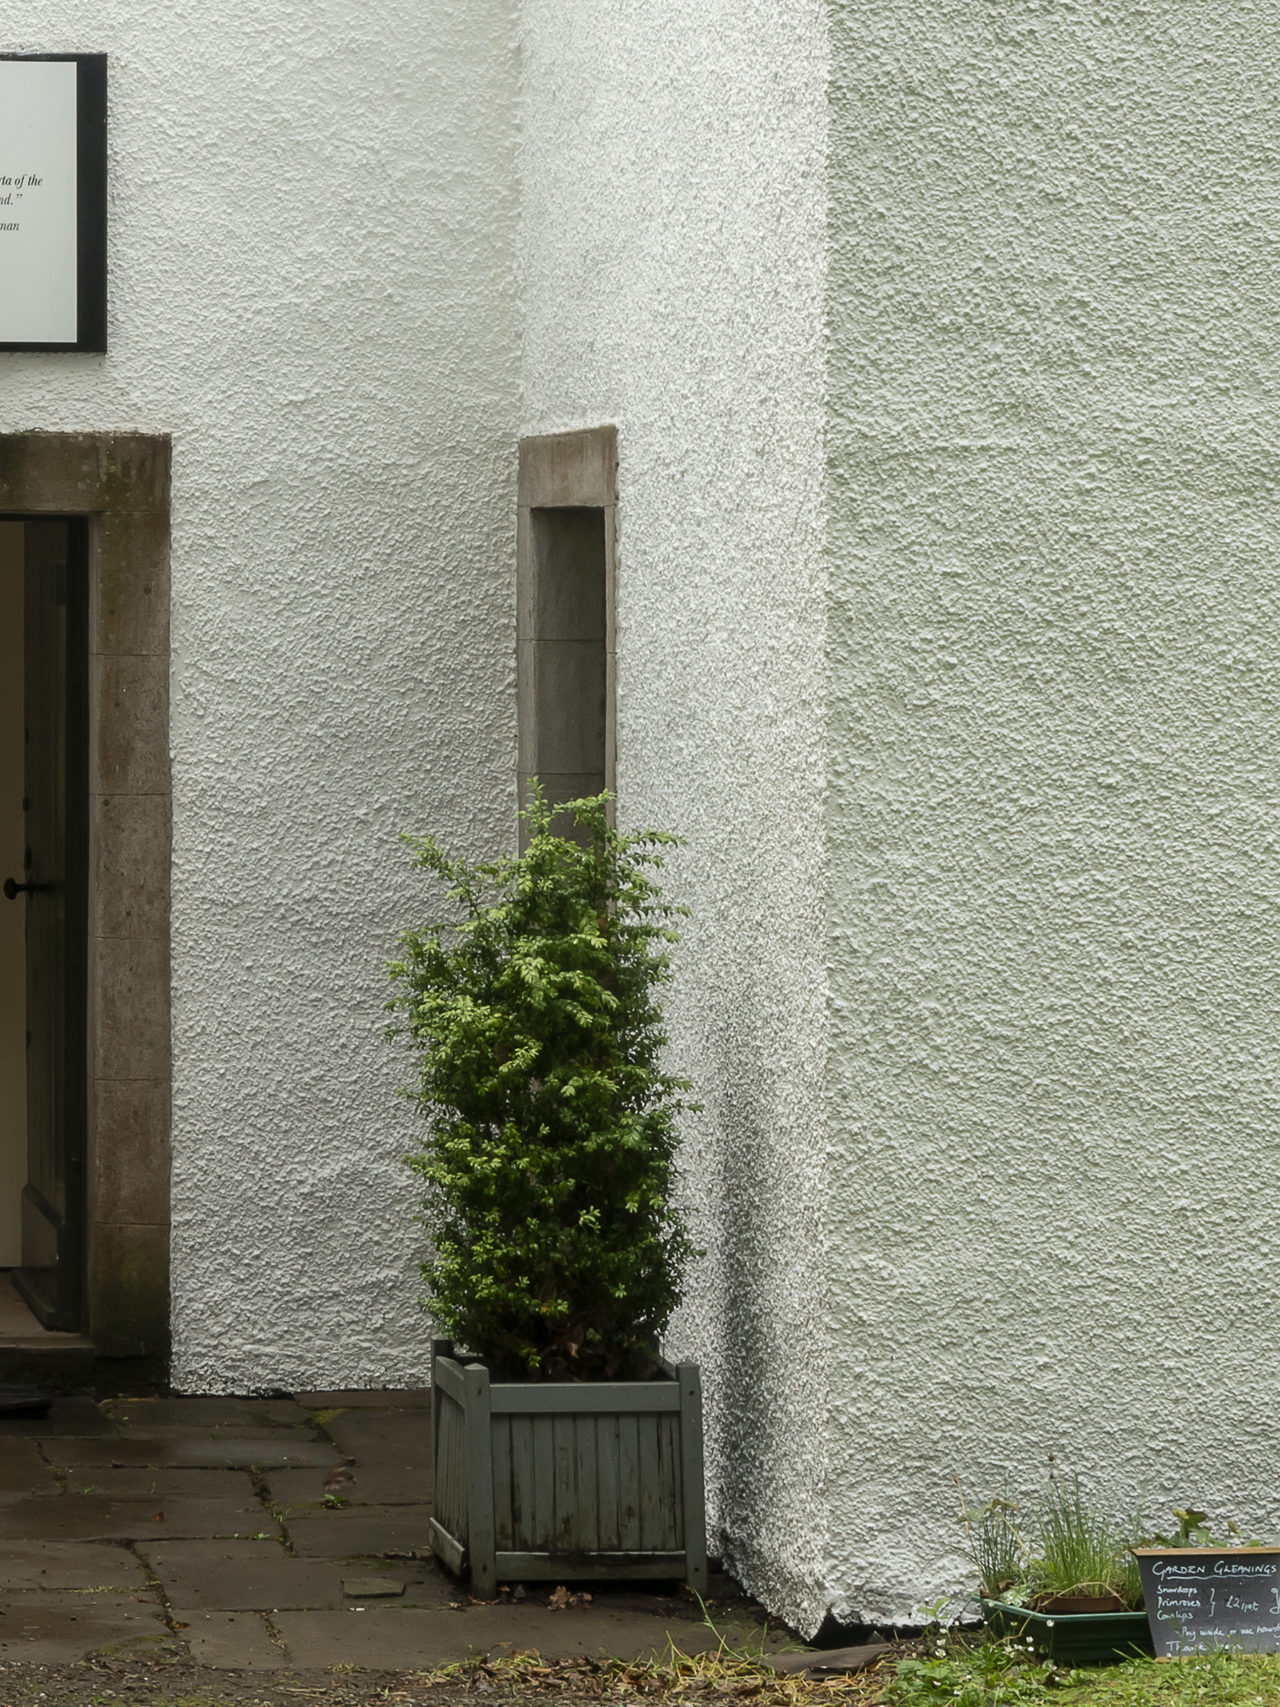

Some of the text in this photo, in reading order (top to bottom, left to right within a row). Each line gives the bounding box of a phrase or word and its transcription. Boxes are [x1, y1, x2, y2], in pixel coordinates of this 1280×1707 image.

[14, 172, 27, 189] of
[27, 173, 43, 186] the
[1152, 1560, 1277, 1581] GARDEN GLEANINGS
[1158, 1596, 1201, 1608] Primroses
